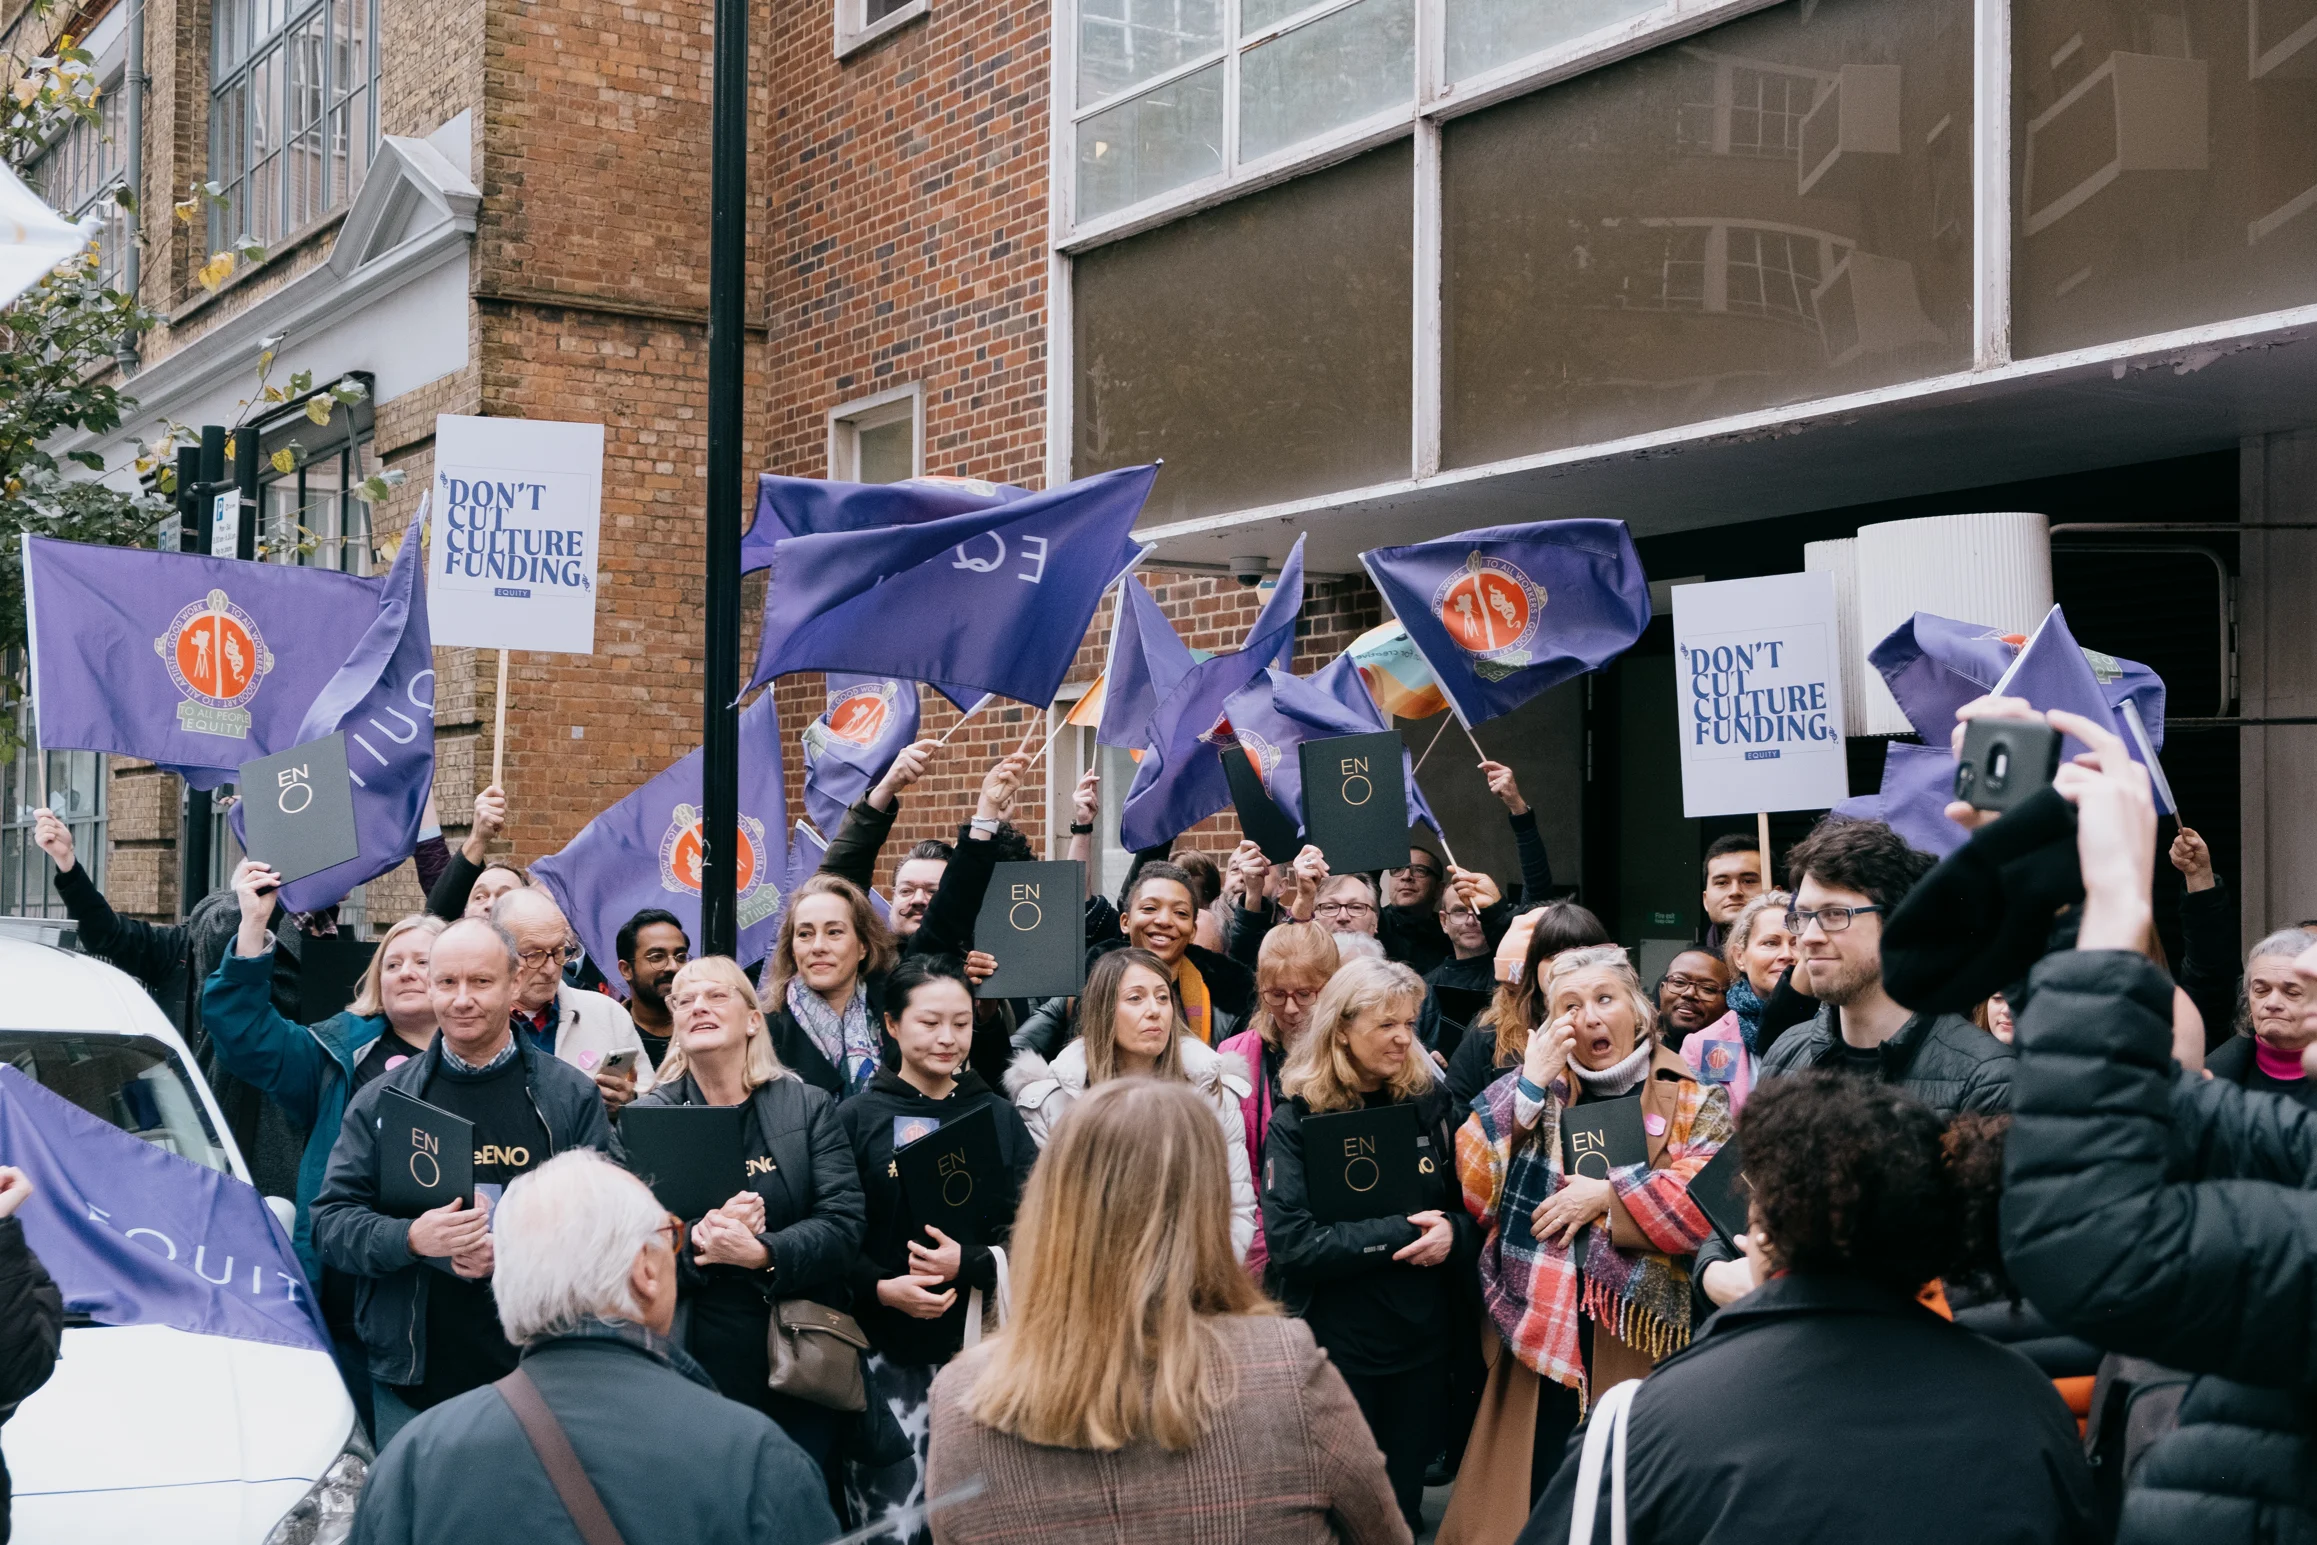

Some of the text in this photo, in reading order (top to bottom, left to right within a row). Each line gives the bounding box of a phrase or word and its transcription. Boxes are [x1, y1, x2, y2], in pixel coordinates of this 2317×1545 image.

[449, 479, 546, 510] DON'T
[448, 504, 509, 531] CUT
[446, 529, 583, 557] CULTURE
[445, 552, 581, 586] FUNDING
[1487, 560, 1498, 568] TO
[1500, 564, 1515, 575] ALL
[497, 589, 528, 597] EQUITY
[1441, 570, 1465, 591] WORK
[1515, 572, 1538, 614] WORKERS
[1515, 621, 1536, 647] GOOD
[168, 603, 263, 707] GOOD WORK TO ALL WORKERS GOOD ART TO ALL ARTISTS
[1691, 641, 1783, 675] DON'T
[835, 685, 881, 705] GOOD WORK
[1692, 670, 1750, 699] CUT
[179, 705, 249, 724] TO ALL PEOPLE
[1693, 682, 1827, 722] CULTURE
[186, 718, 243, 735] EQUITY
[1696, 713, 1827, 745] FUNDING
[1241, 732, 1270, 776] ALL WORKERS
[1748, 751, 1778, 759] EQUITY
[474, 1145, 529, 1166] eENO
